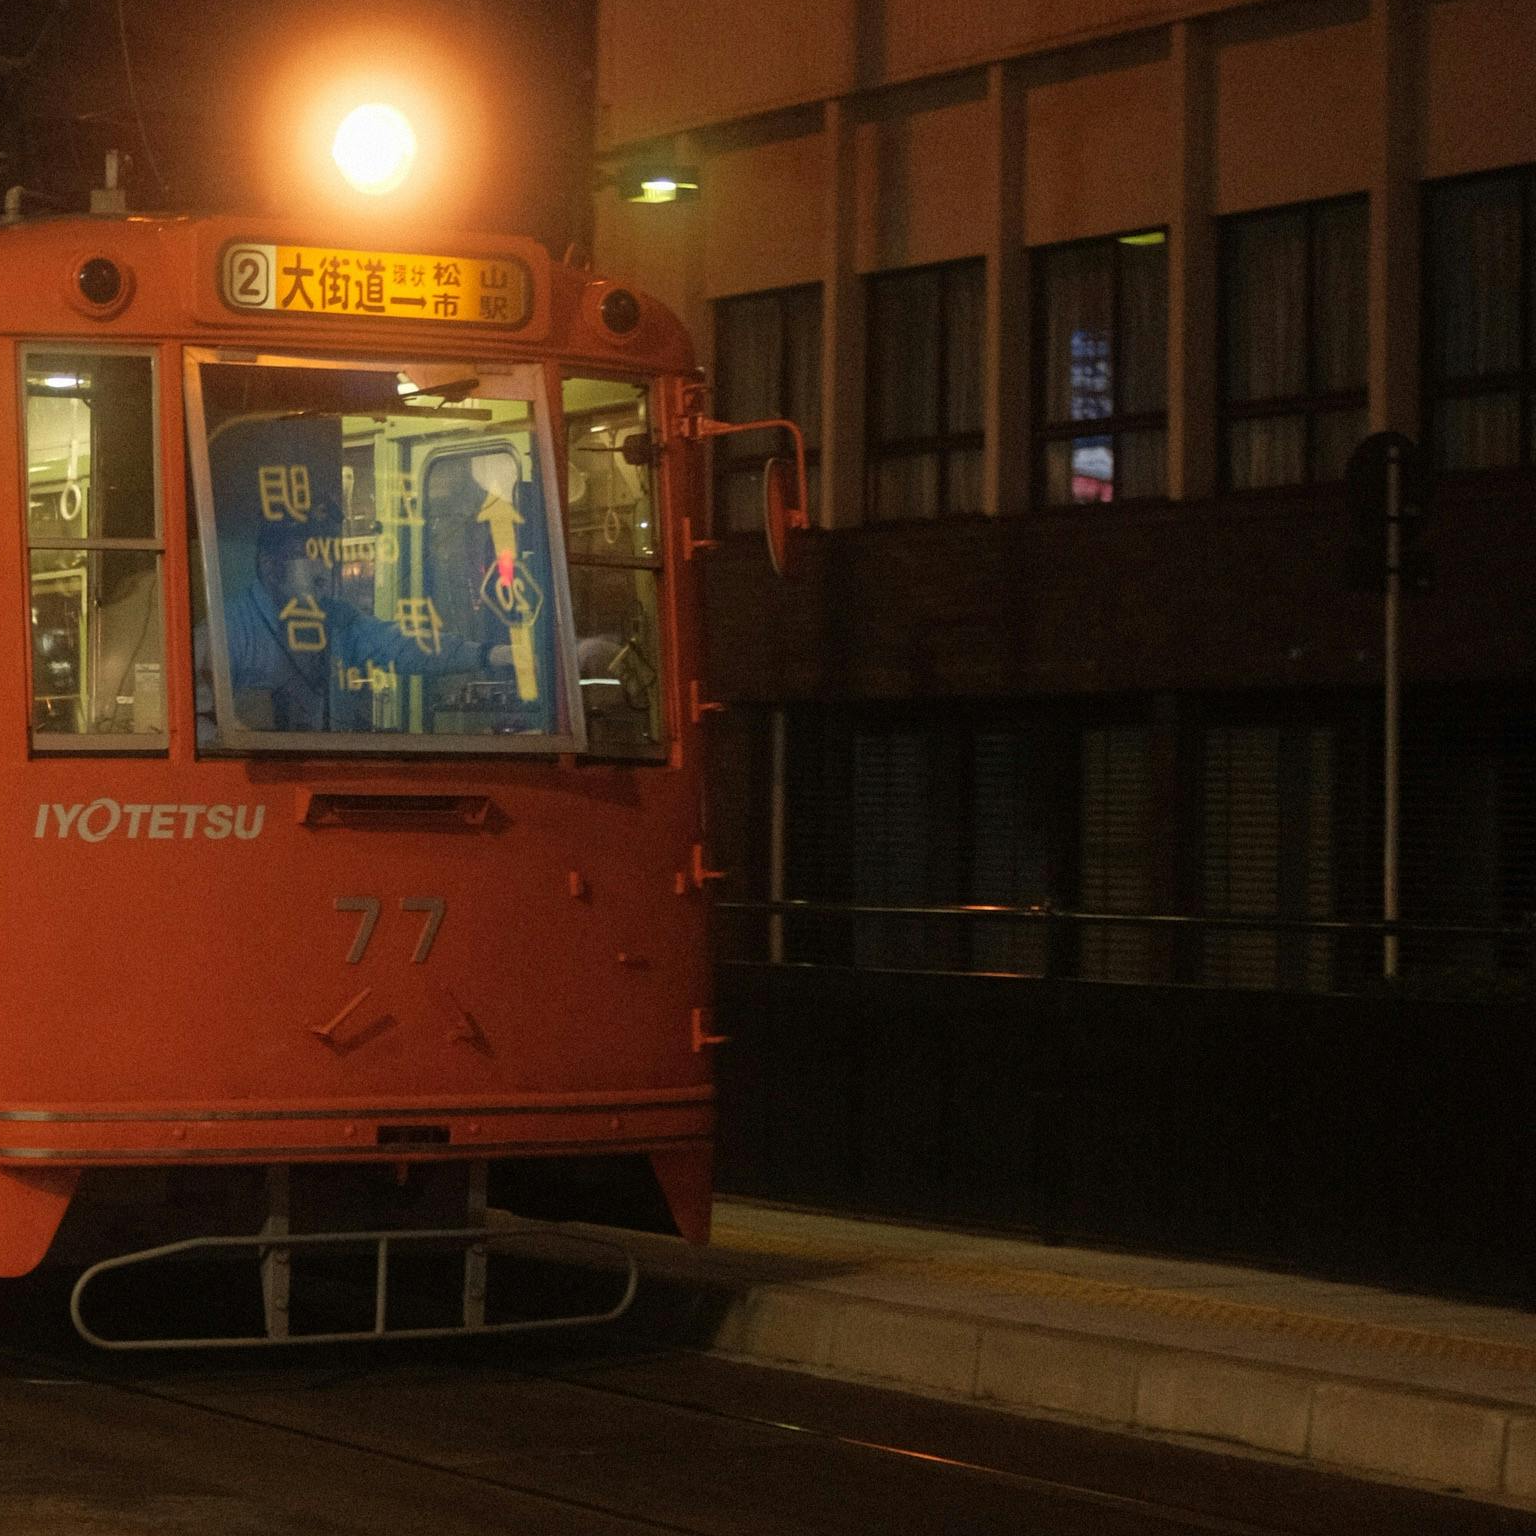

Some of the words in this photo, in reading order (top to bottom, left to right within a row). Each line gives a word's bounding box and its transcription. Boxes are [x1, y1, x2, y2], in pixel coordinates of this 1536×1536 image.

[238, 258, 260, 297] 2
[281, 252, 387, 313] 大街道
[34, 797, 266, 843] IYOTETSU
[334, 896, 448, 965] 77
